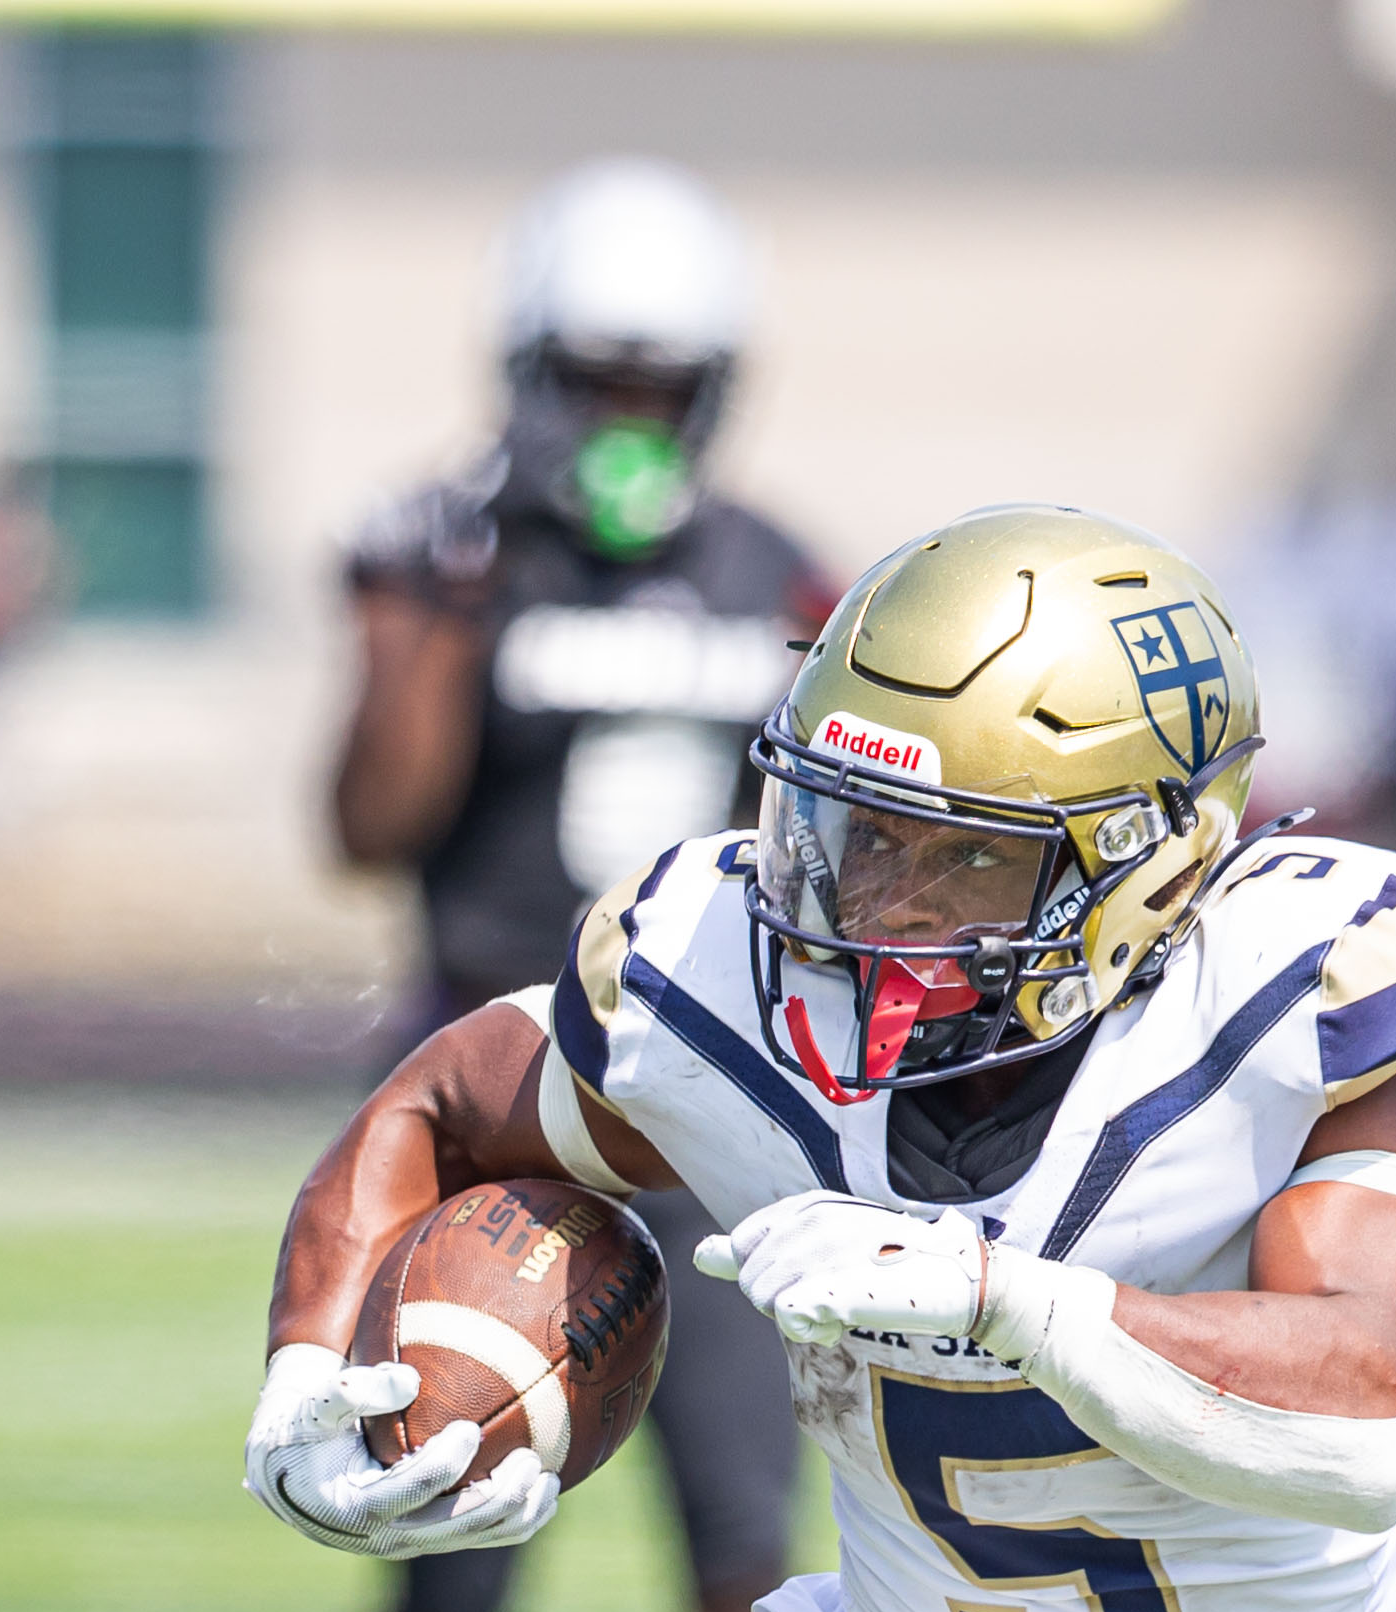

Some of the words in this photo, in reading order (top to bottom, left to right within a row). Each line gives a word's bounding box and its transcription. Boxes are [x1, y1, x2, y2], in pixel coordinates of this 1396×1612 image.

[825, 720, 922, 771] Riddell
[791, 804, 828, 880] ddell
[1034, 886, 1091, 942] ddell
[516, 1203, 609, 1283] Wilson
